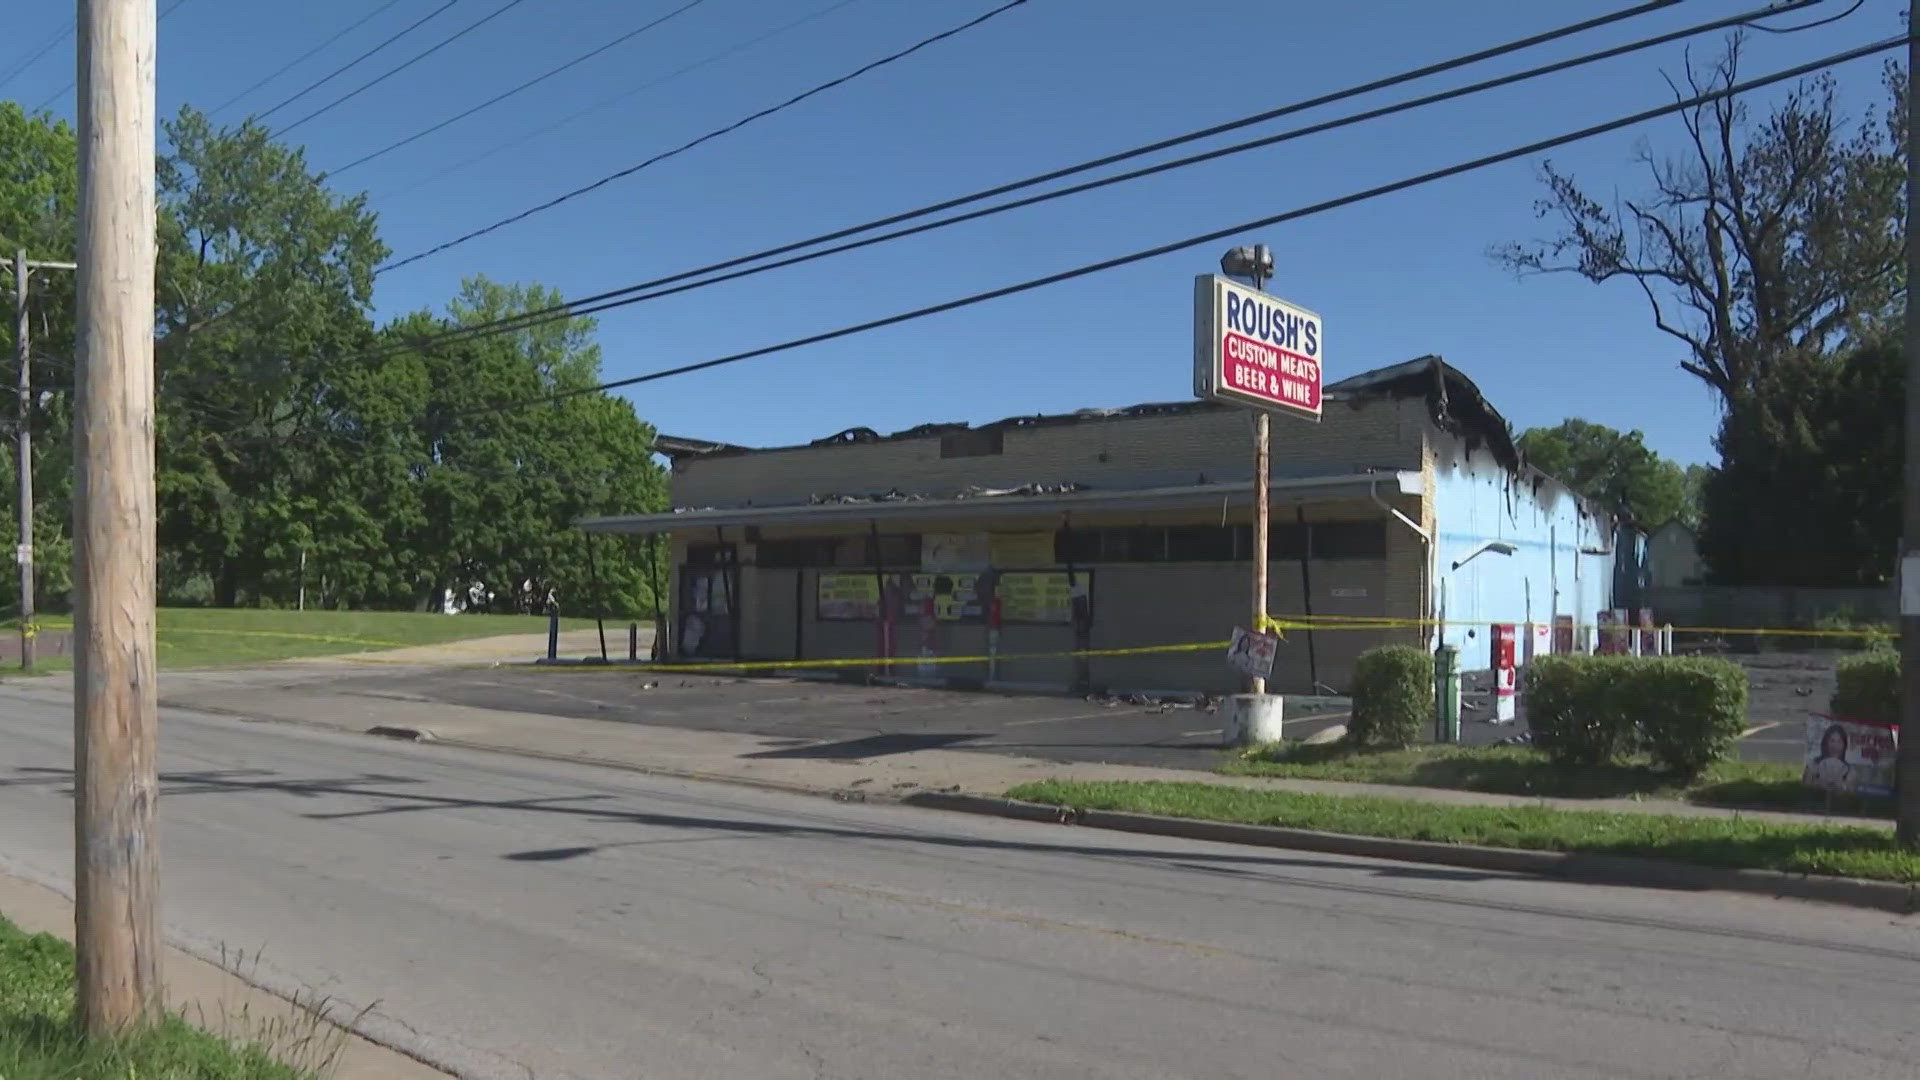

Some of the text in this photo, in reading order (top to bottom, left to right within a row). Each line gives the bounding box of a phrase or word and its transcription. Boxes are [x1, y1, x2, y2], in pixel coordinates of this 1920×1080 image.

[1227, 291, 1317, 356] ROUSH'S
[1229, 337, 1317, 382] CUSTOM MEATS
[1235, 364, 1311, 405] BEER & WINE
